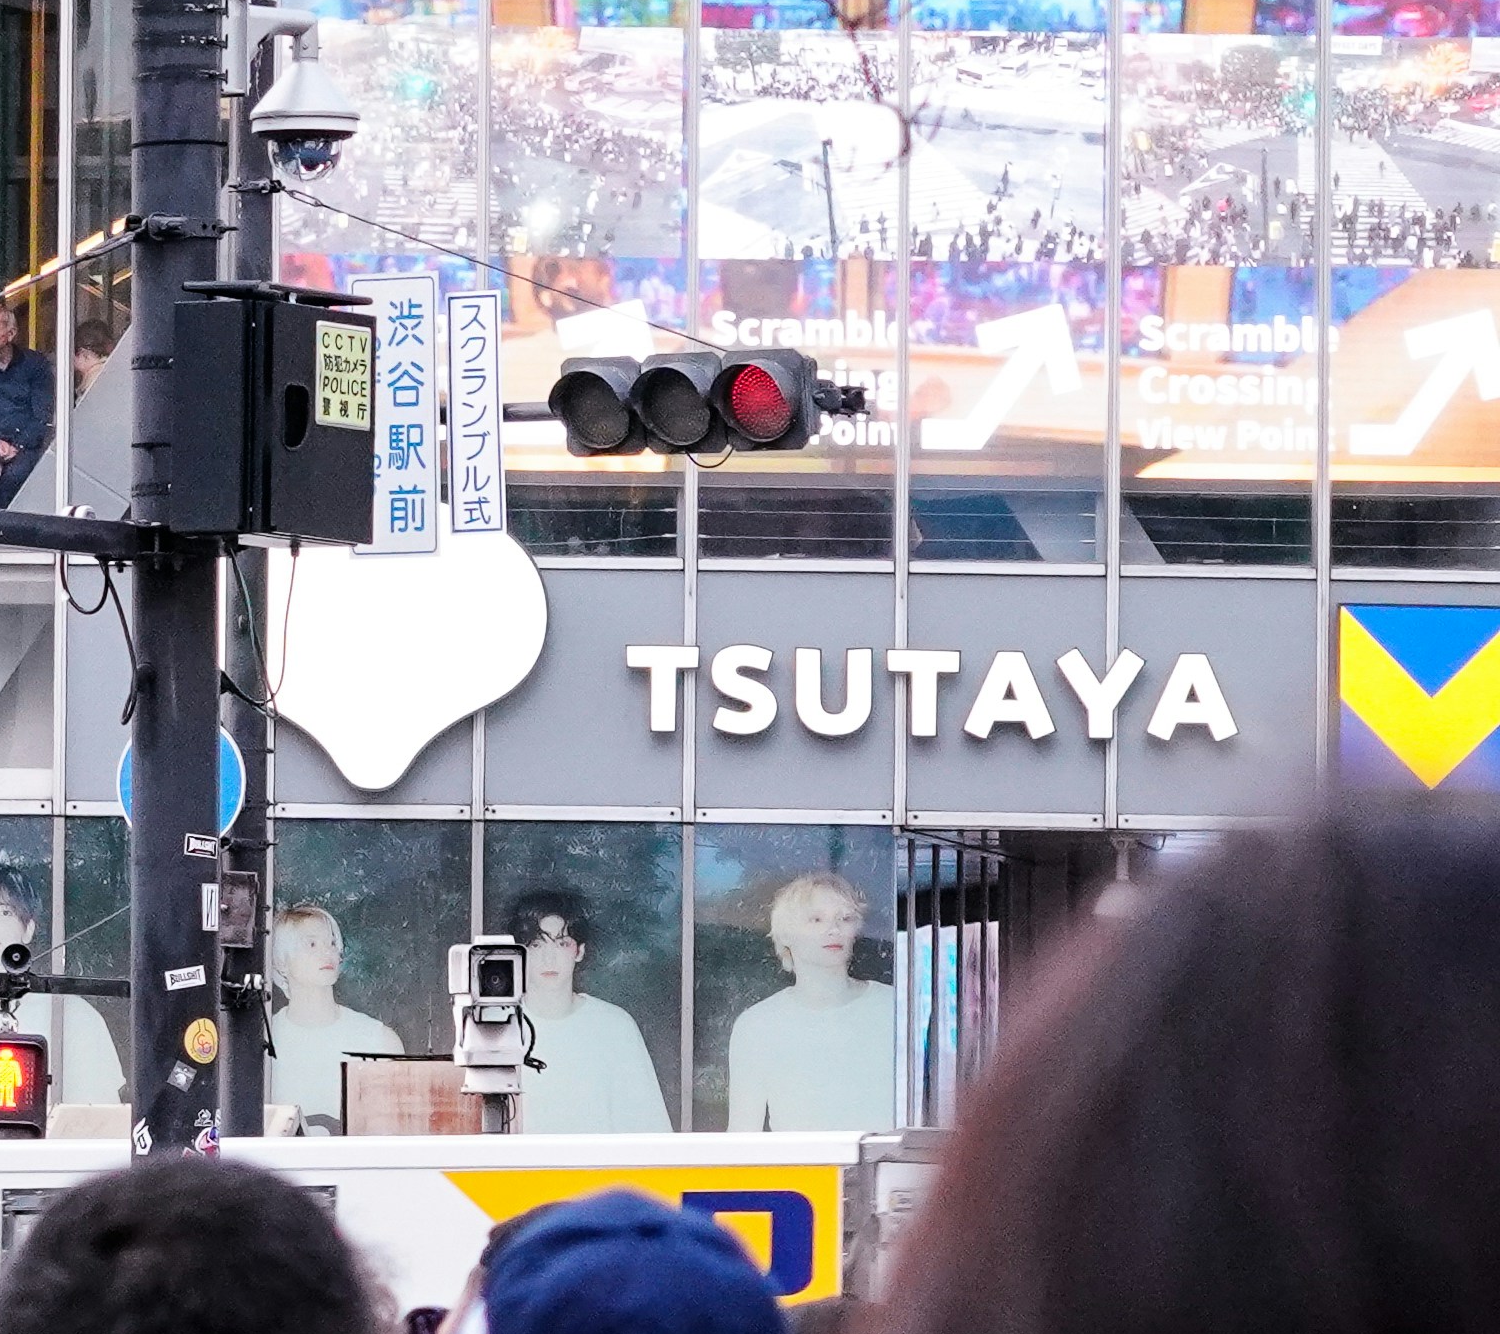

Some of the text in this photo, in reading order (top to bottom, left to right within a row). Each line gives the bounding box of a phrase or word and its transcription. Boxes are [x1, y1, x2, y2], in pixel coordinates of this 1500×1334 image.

[322, 331, 368, 353] CCTV
[323, 353, 368, 374] 防犯カメラ
[322, 376, 368, 398] POLICE
[388, 298, 426, 533] 渋谷駅前
[460, 304, 491, 525] スクランブル式
[626, 644, 1240, 742] TSUTAYA
